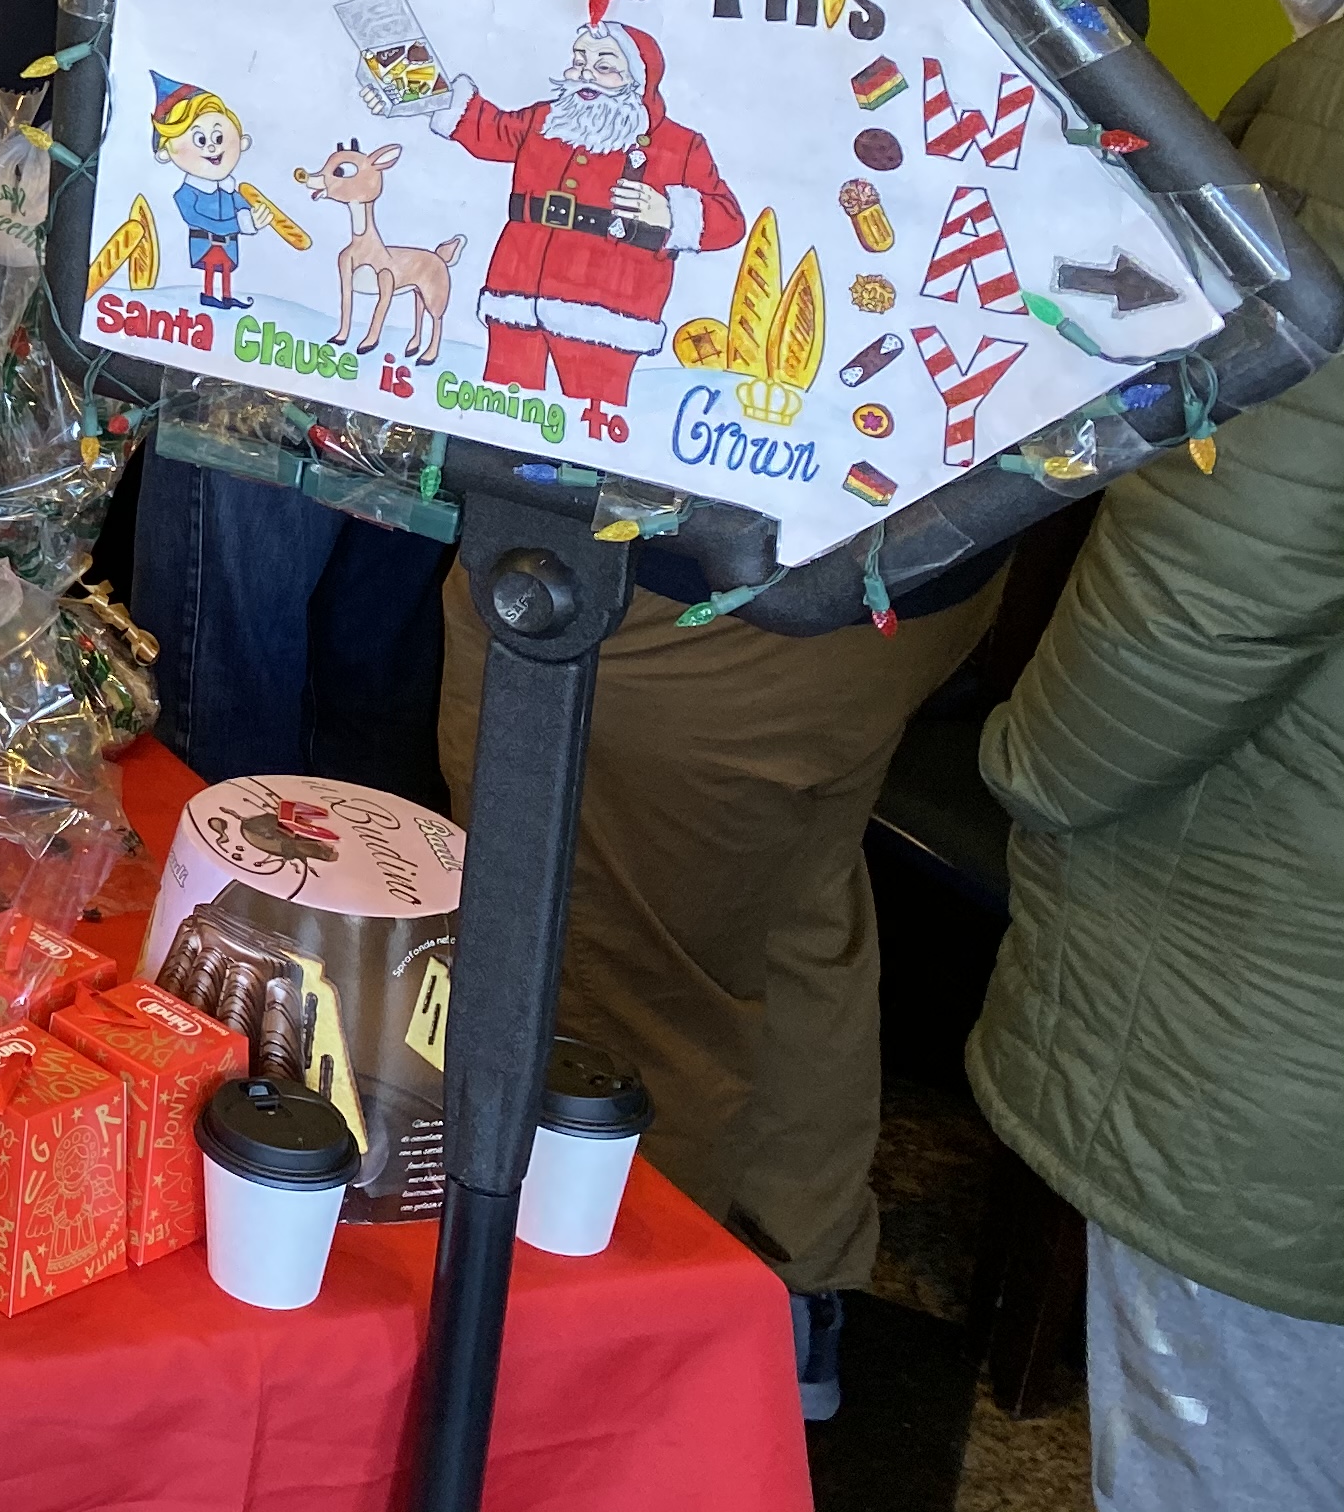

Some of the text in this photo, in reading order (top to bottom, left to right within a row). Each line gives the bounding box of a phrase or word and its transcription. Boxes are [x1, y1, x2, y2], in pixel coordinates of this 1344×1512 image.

[909, 56, 1036, 467] WAY
[96, 293, 215, 352] Santa
[233, 314, 359, 381] Clause
[378, 352, 415, 399] is
[435, 370, 566, 444] Coming
[580, 398, 630, 444] to
[143, 1002, 195, 1032] bindi
